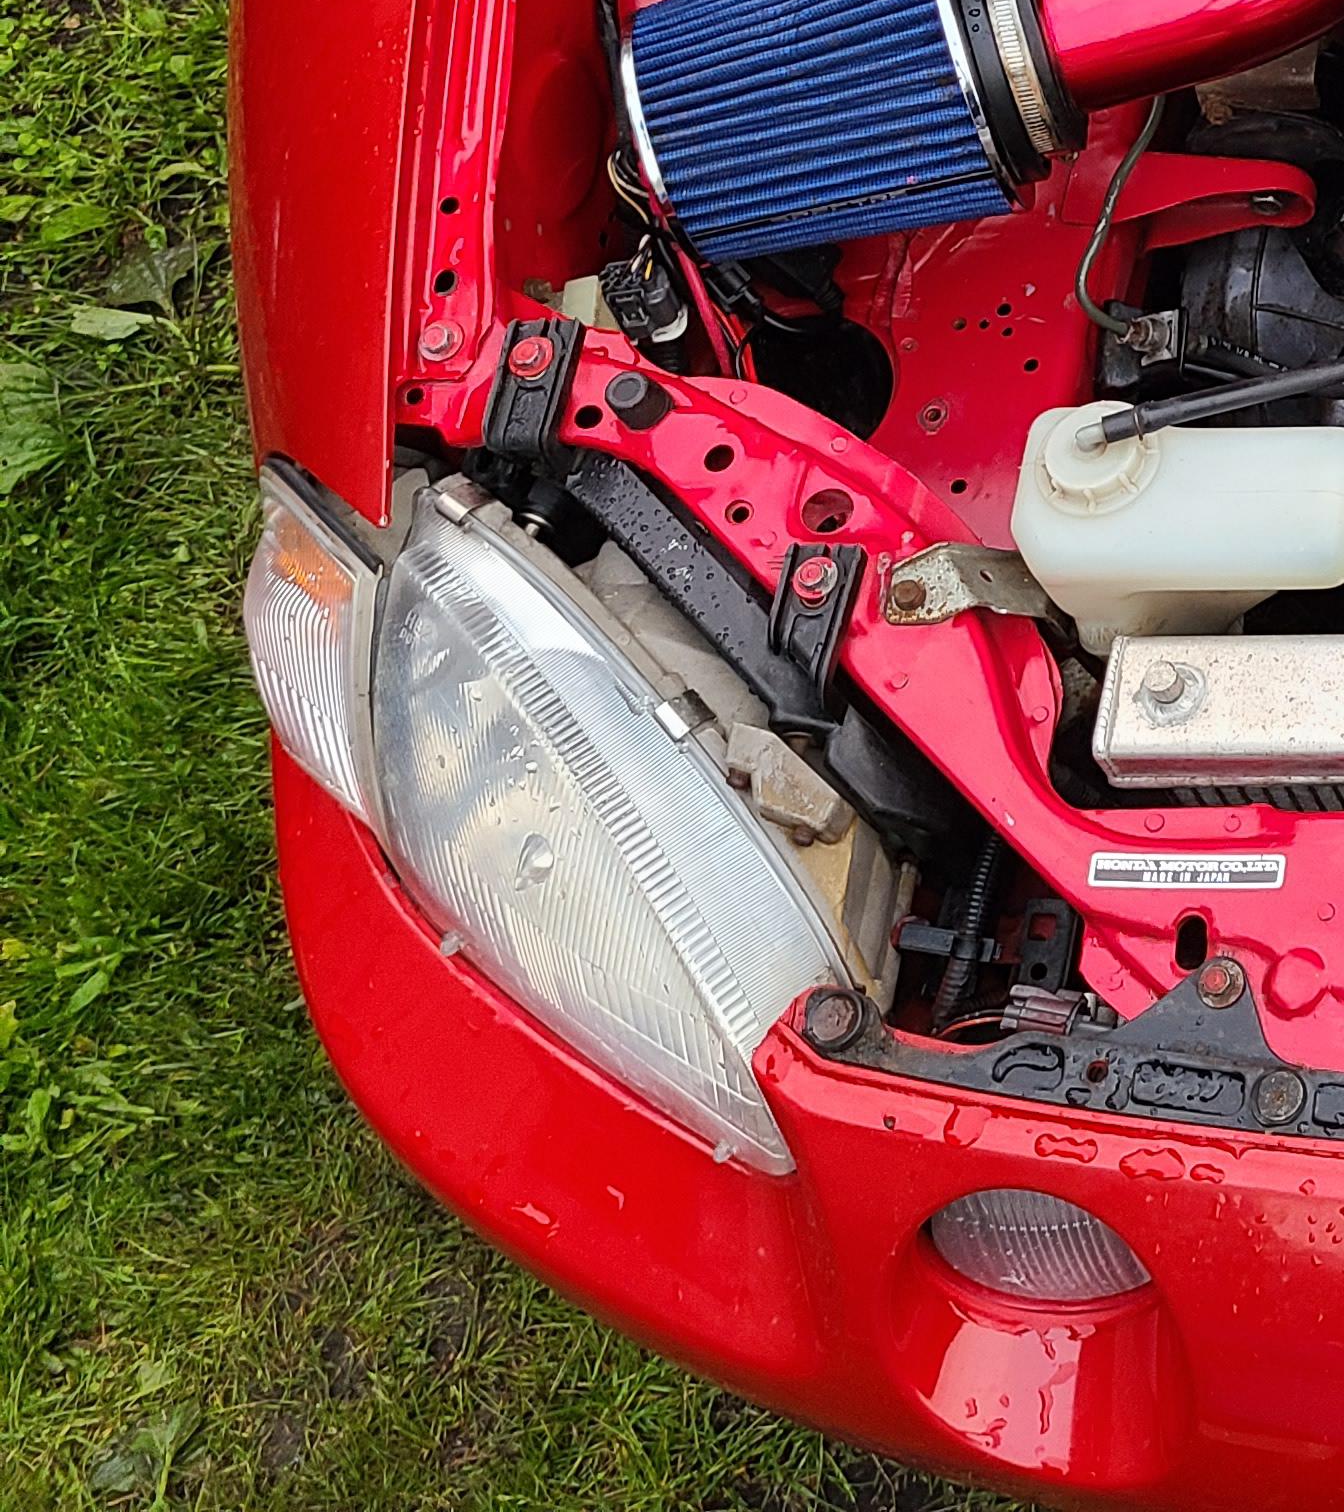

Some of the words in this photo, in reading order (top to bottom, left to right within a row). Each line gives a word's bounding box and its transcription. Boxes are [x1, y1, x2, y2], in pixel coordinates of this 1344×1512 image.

[1097, 859, 1157, 871] HONDA
[1159, 860, 1219, 871] MOTOR
[1142, 871, 1173, 882] MADE
[1179, 872, 1191, 882] IN
[1197, 872, 1231, 882] JAPAN
